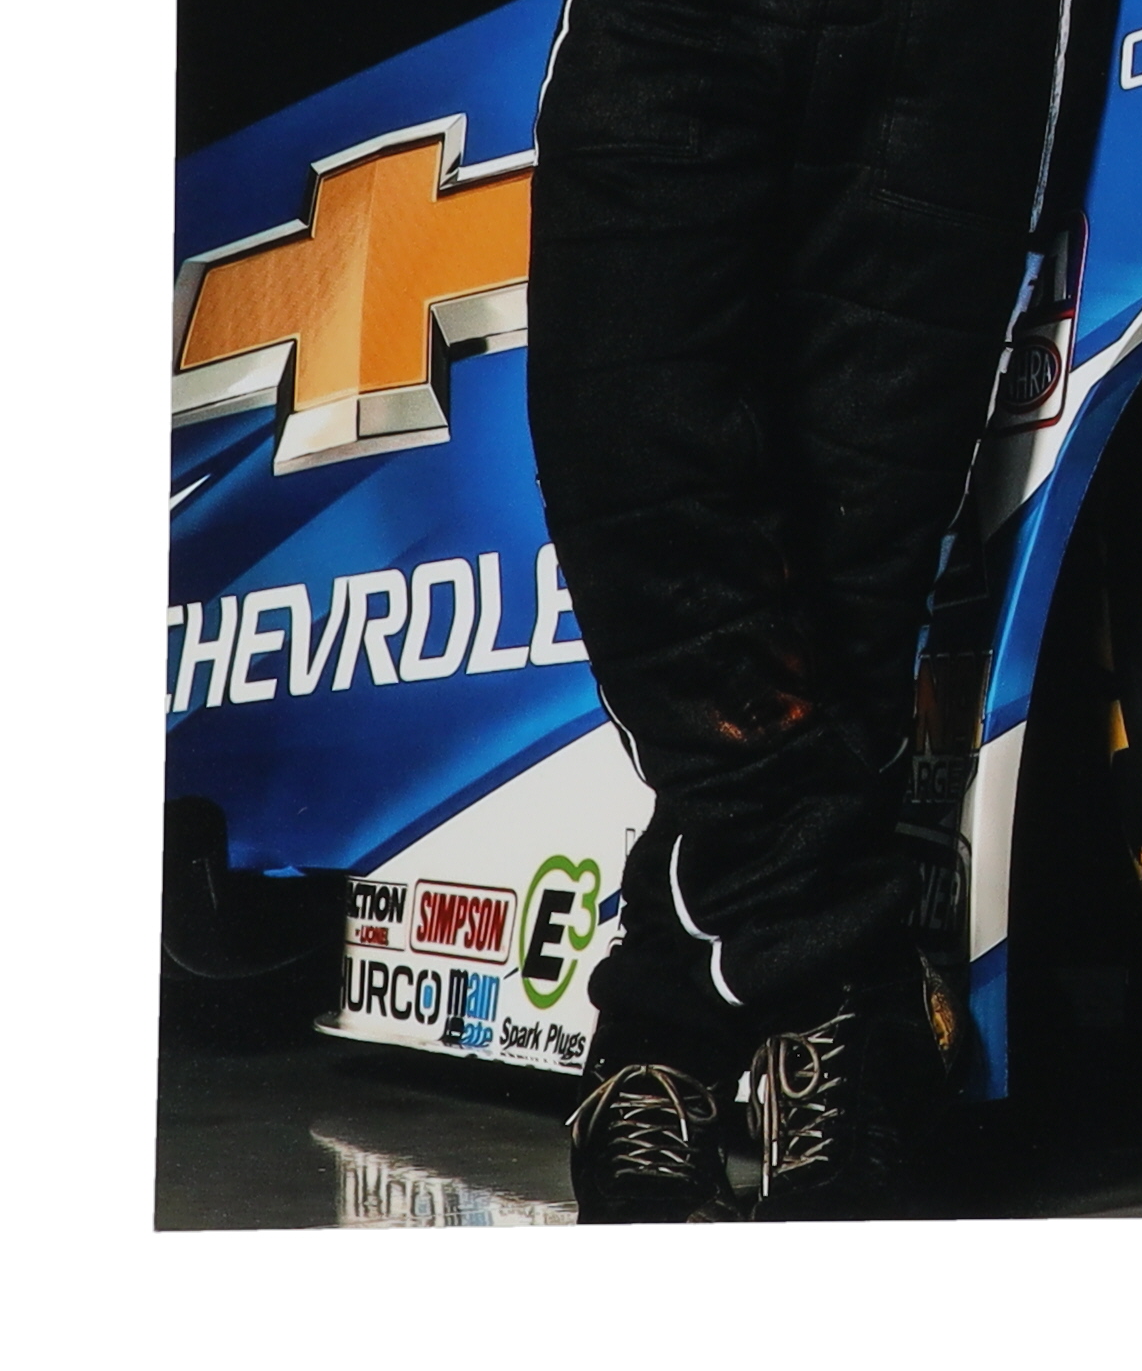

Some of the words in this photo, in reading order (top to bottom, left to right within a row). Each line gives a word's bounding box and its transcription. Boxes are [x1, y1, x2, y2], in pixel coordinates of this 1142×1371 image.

[416, 890, 510, 953] SIMPSON
[449, 968, 500, 1023] main
[500, 1017, 543, 1051] Spark
[544, 1023, 587, 1061] Plugs
